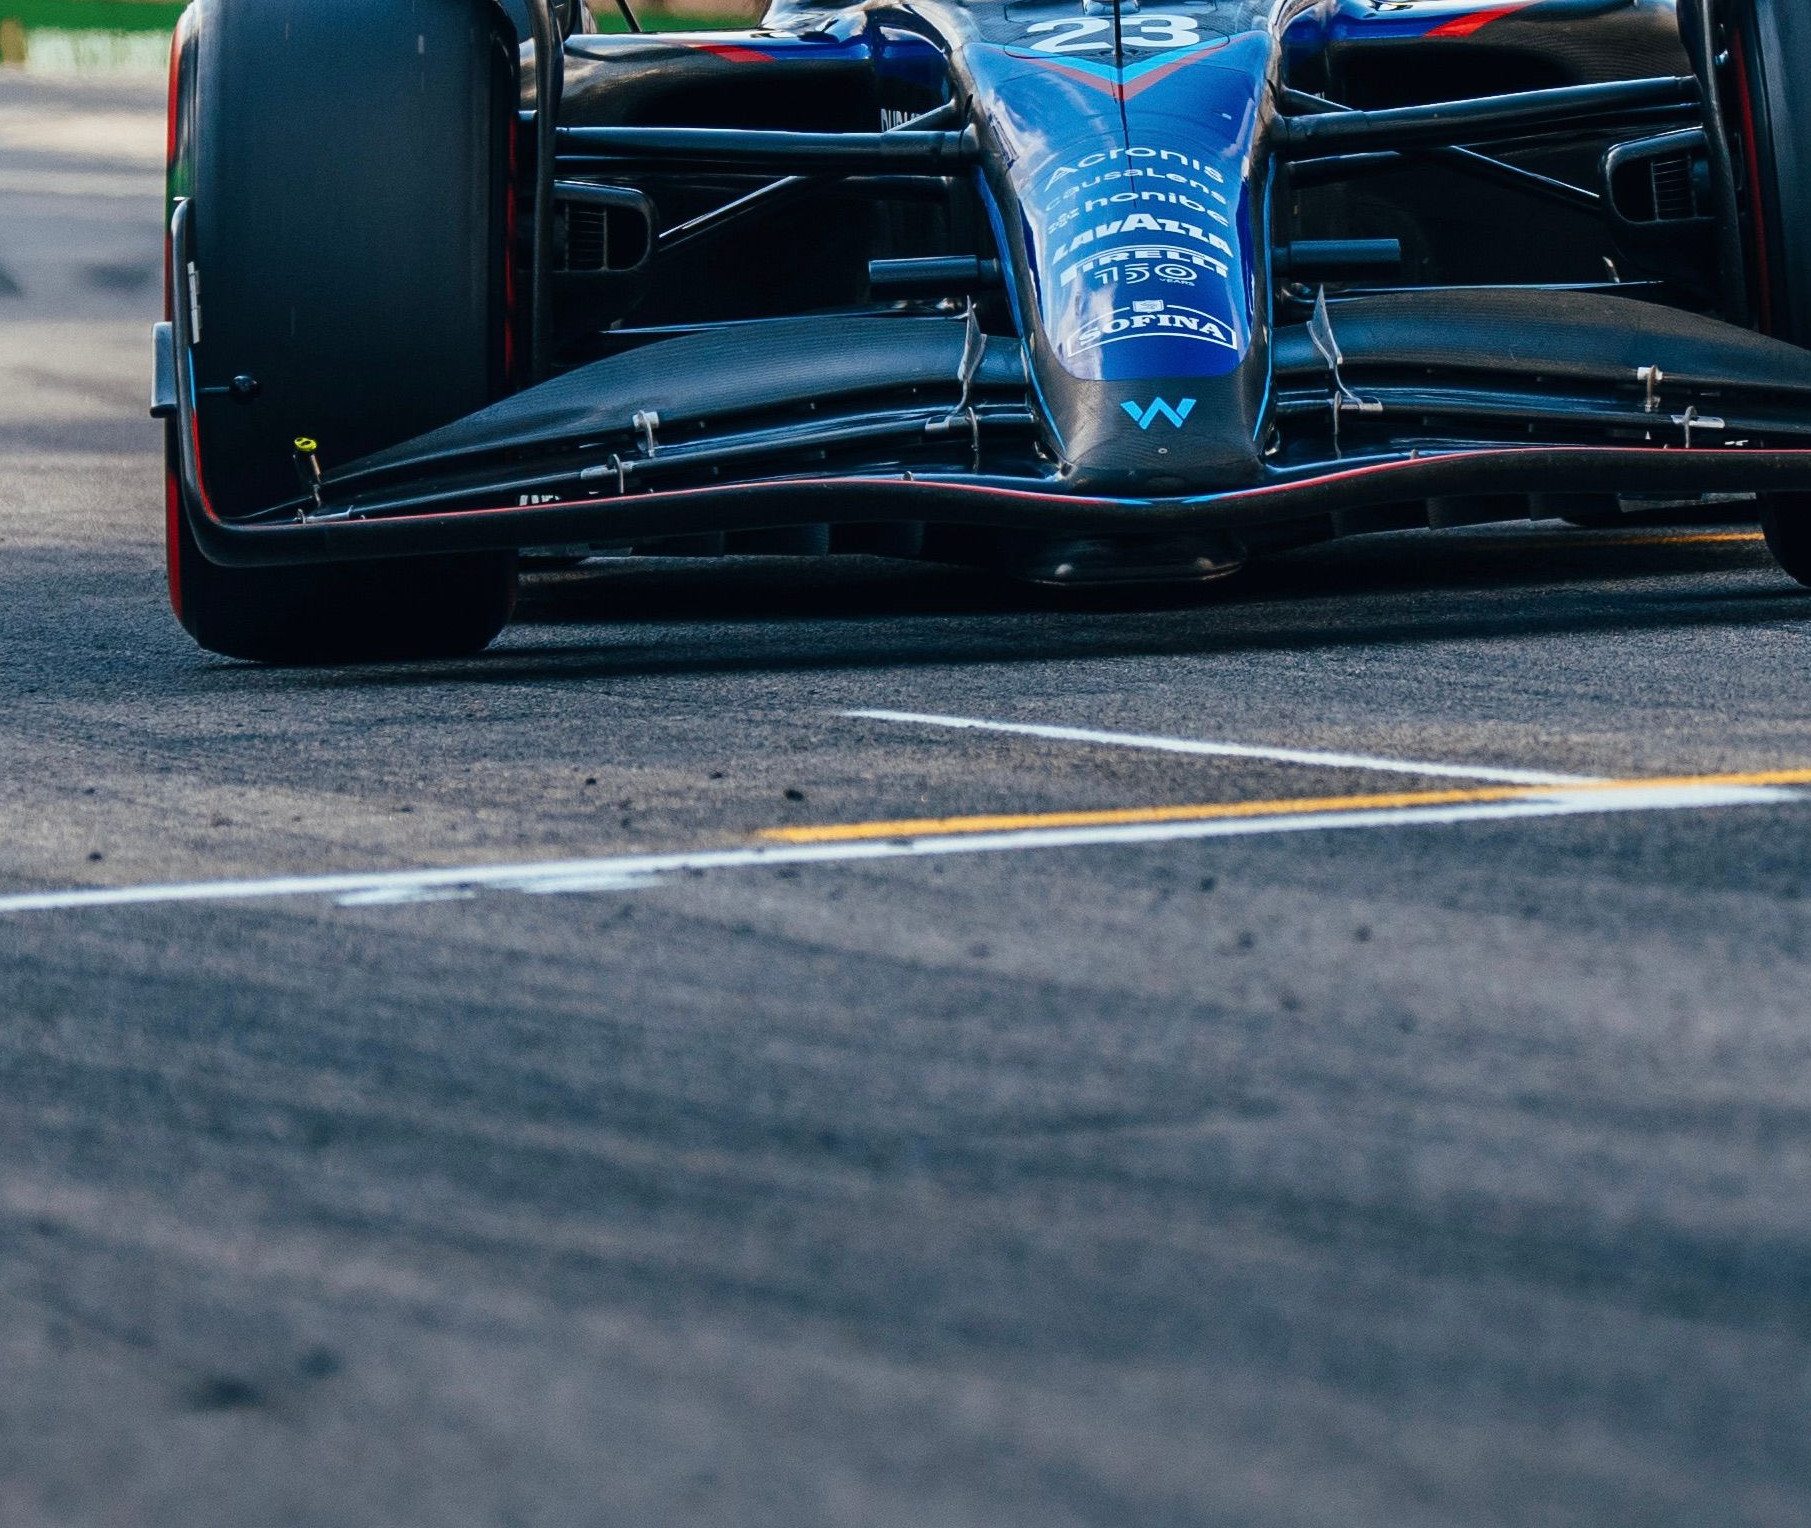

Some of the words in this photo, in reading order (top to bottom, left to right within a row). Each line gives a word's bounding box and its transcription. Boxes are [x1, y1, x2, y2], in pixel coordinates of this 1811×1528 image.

[1025, 15, 1200, 53] 23
[1044, 147, 1224, 192] Acronis
[1045, 167, 1226, 211] causaLens
[1085, 191, 1229, 227] honibe
[1052, 213, 1234, 264] LAVAZZA
[1060, 244, 1229, 287] PIRELLI
[1094, 263, 1197, 285] 150
[1078, 314, 1227, 346] SOFINA
